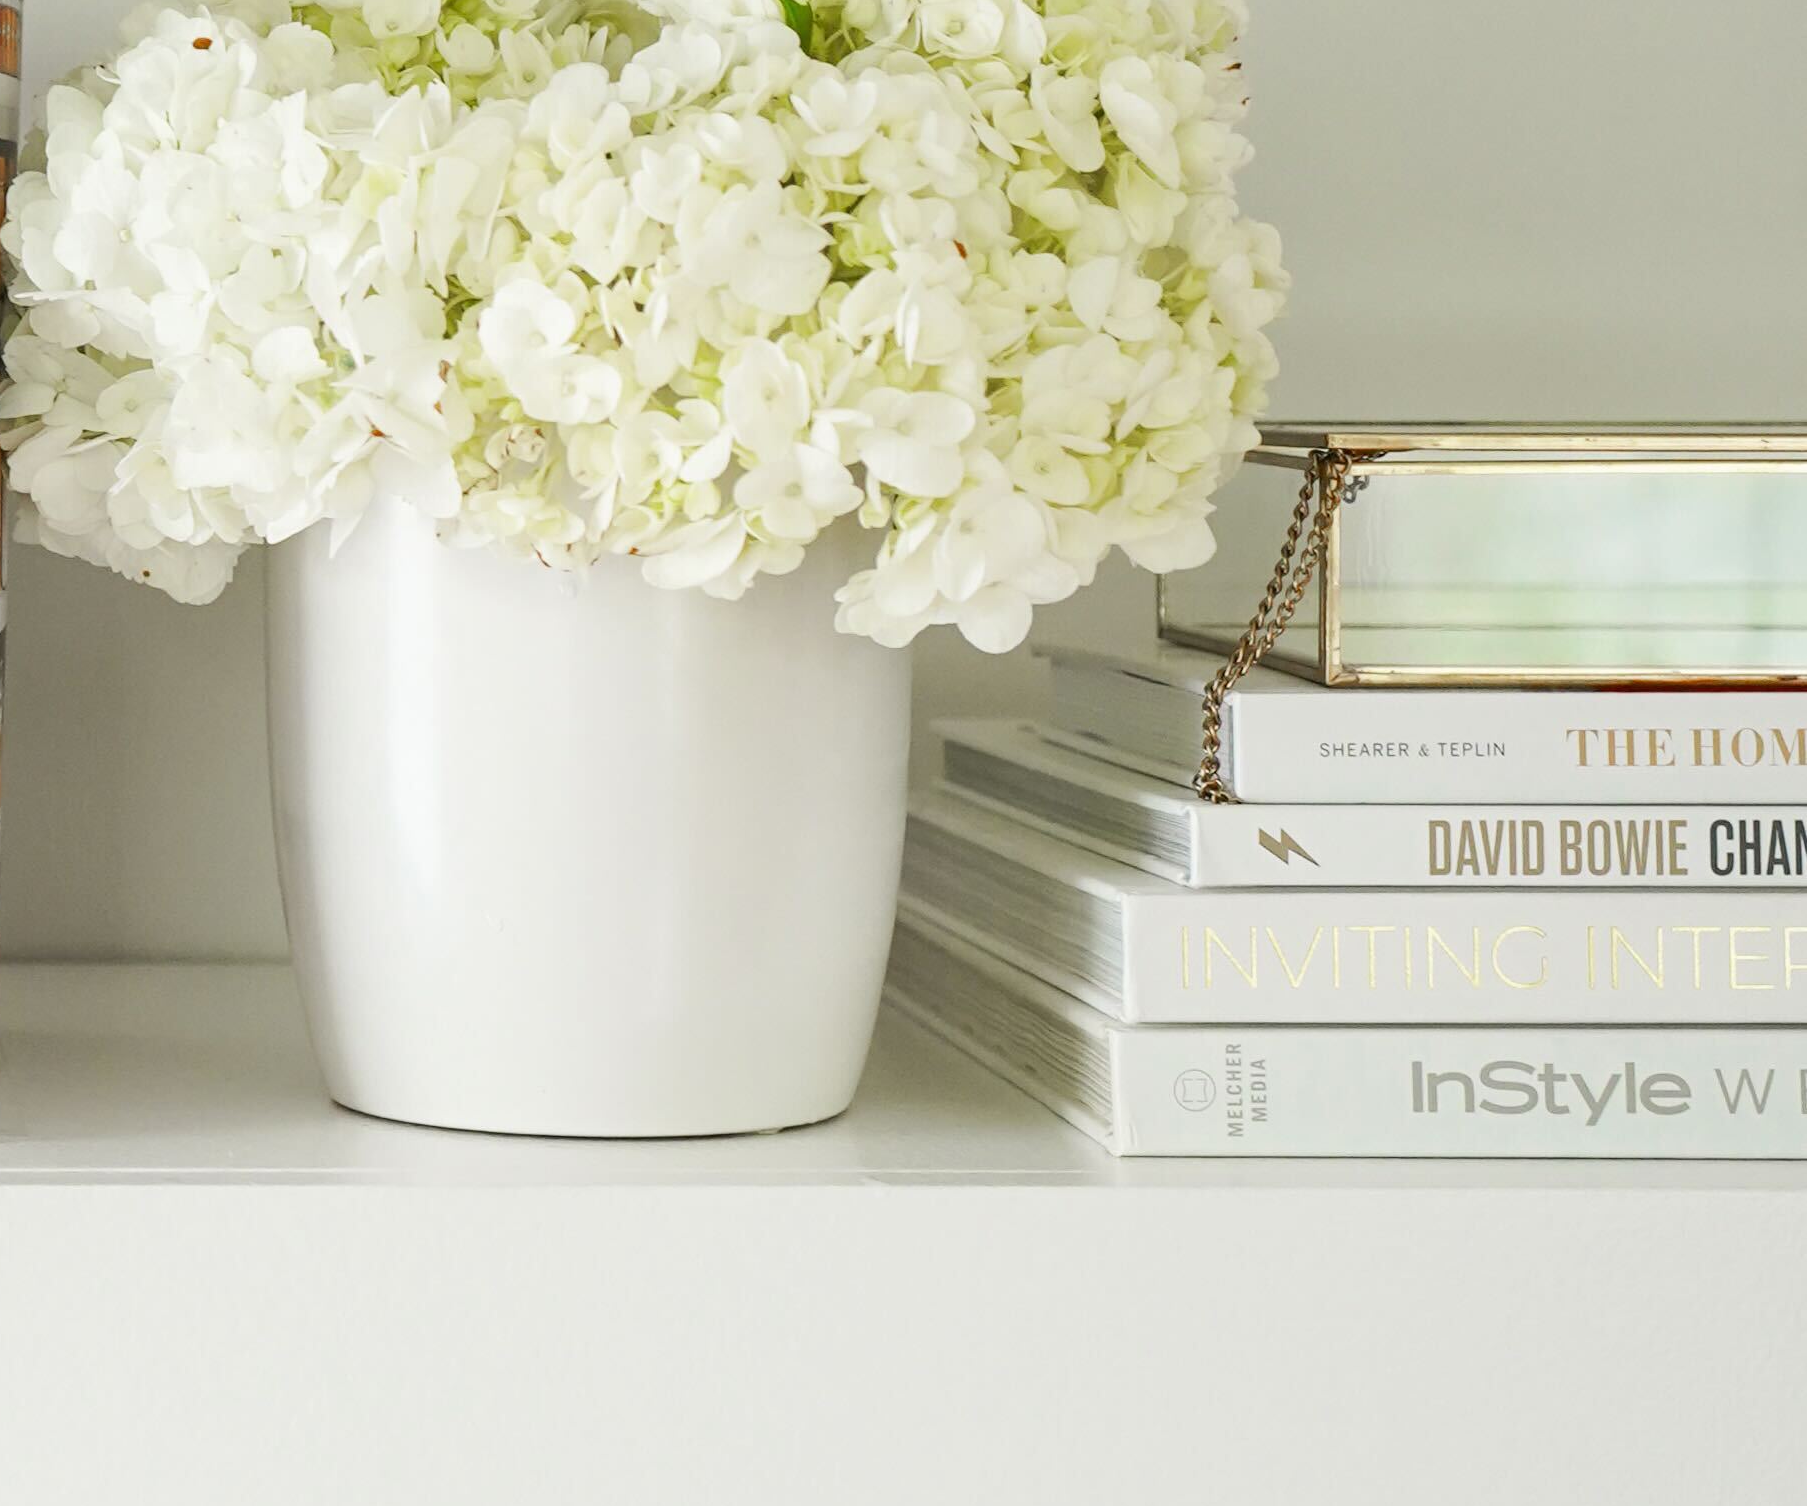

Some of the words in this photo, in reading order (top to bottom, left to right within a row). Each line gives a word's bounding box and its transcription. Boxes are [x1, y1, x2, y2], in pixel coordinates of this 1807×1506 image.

[1319, 742, 1410, 758] SHEARER
[1418, 742, 1430, 758] &
[1437, 742, 1506, 758] TEPLIN
[1566, 727, 1676, 767] THE
[1428, 819, 1545, 877] DAVID
[1560, 819, 1688, 877] BOWIE
[1182, 925, 1548, 990] INVITING
[1227, 1042, 1243, 1138] MELCHER
[1251, 1058, 1267, 1123] MEDIA
[1411, 1061, 1693, 1128] InStyle
